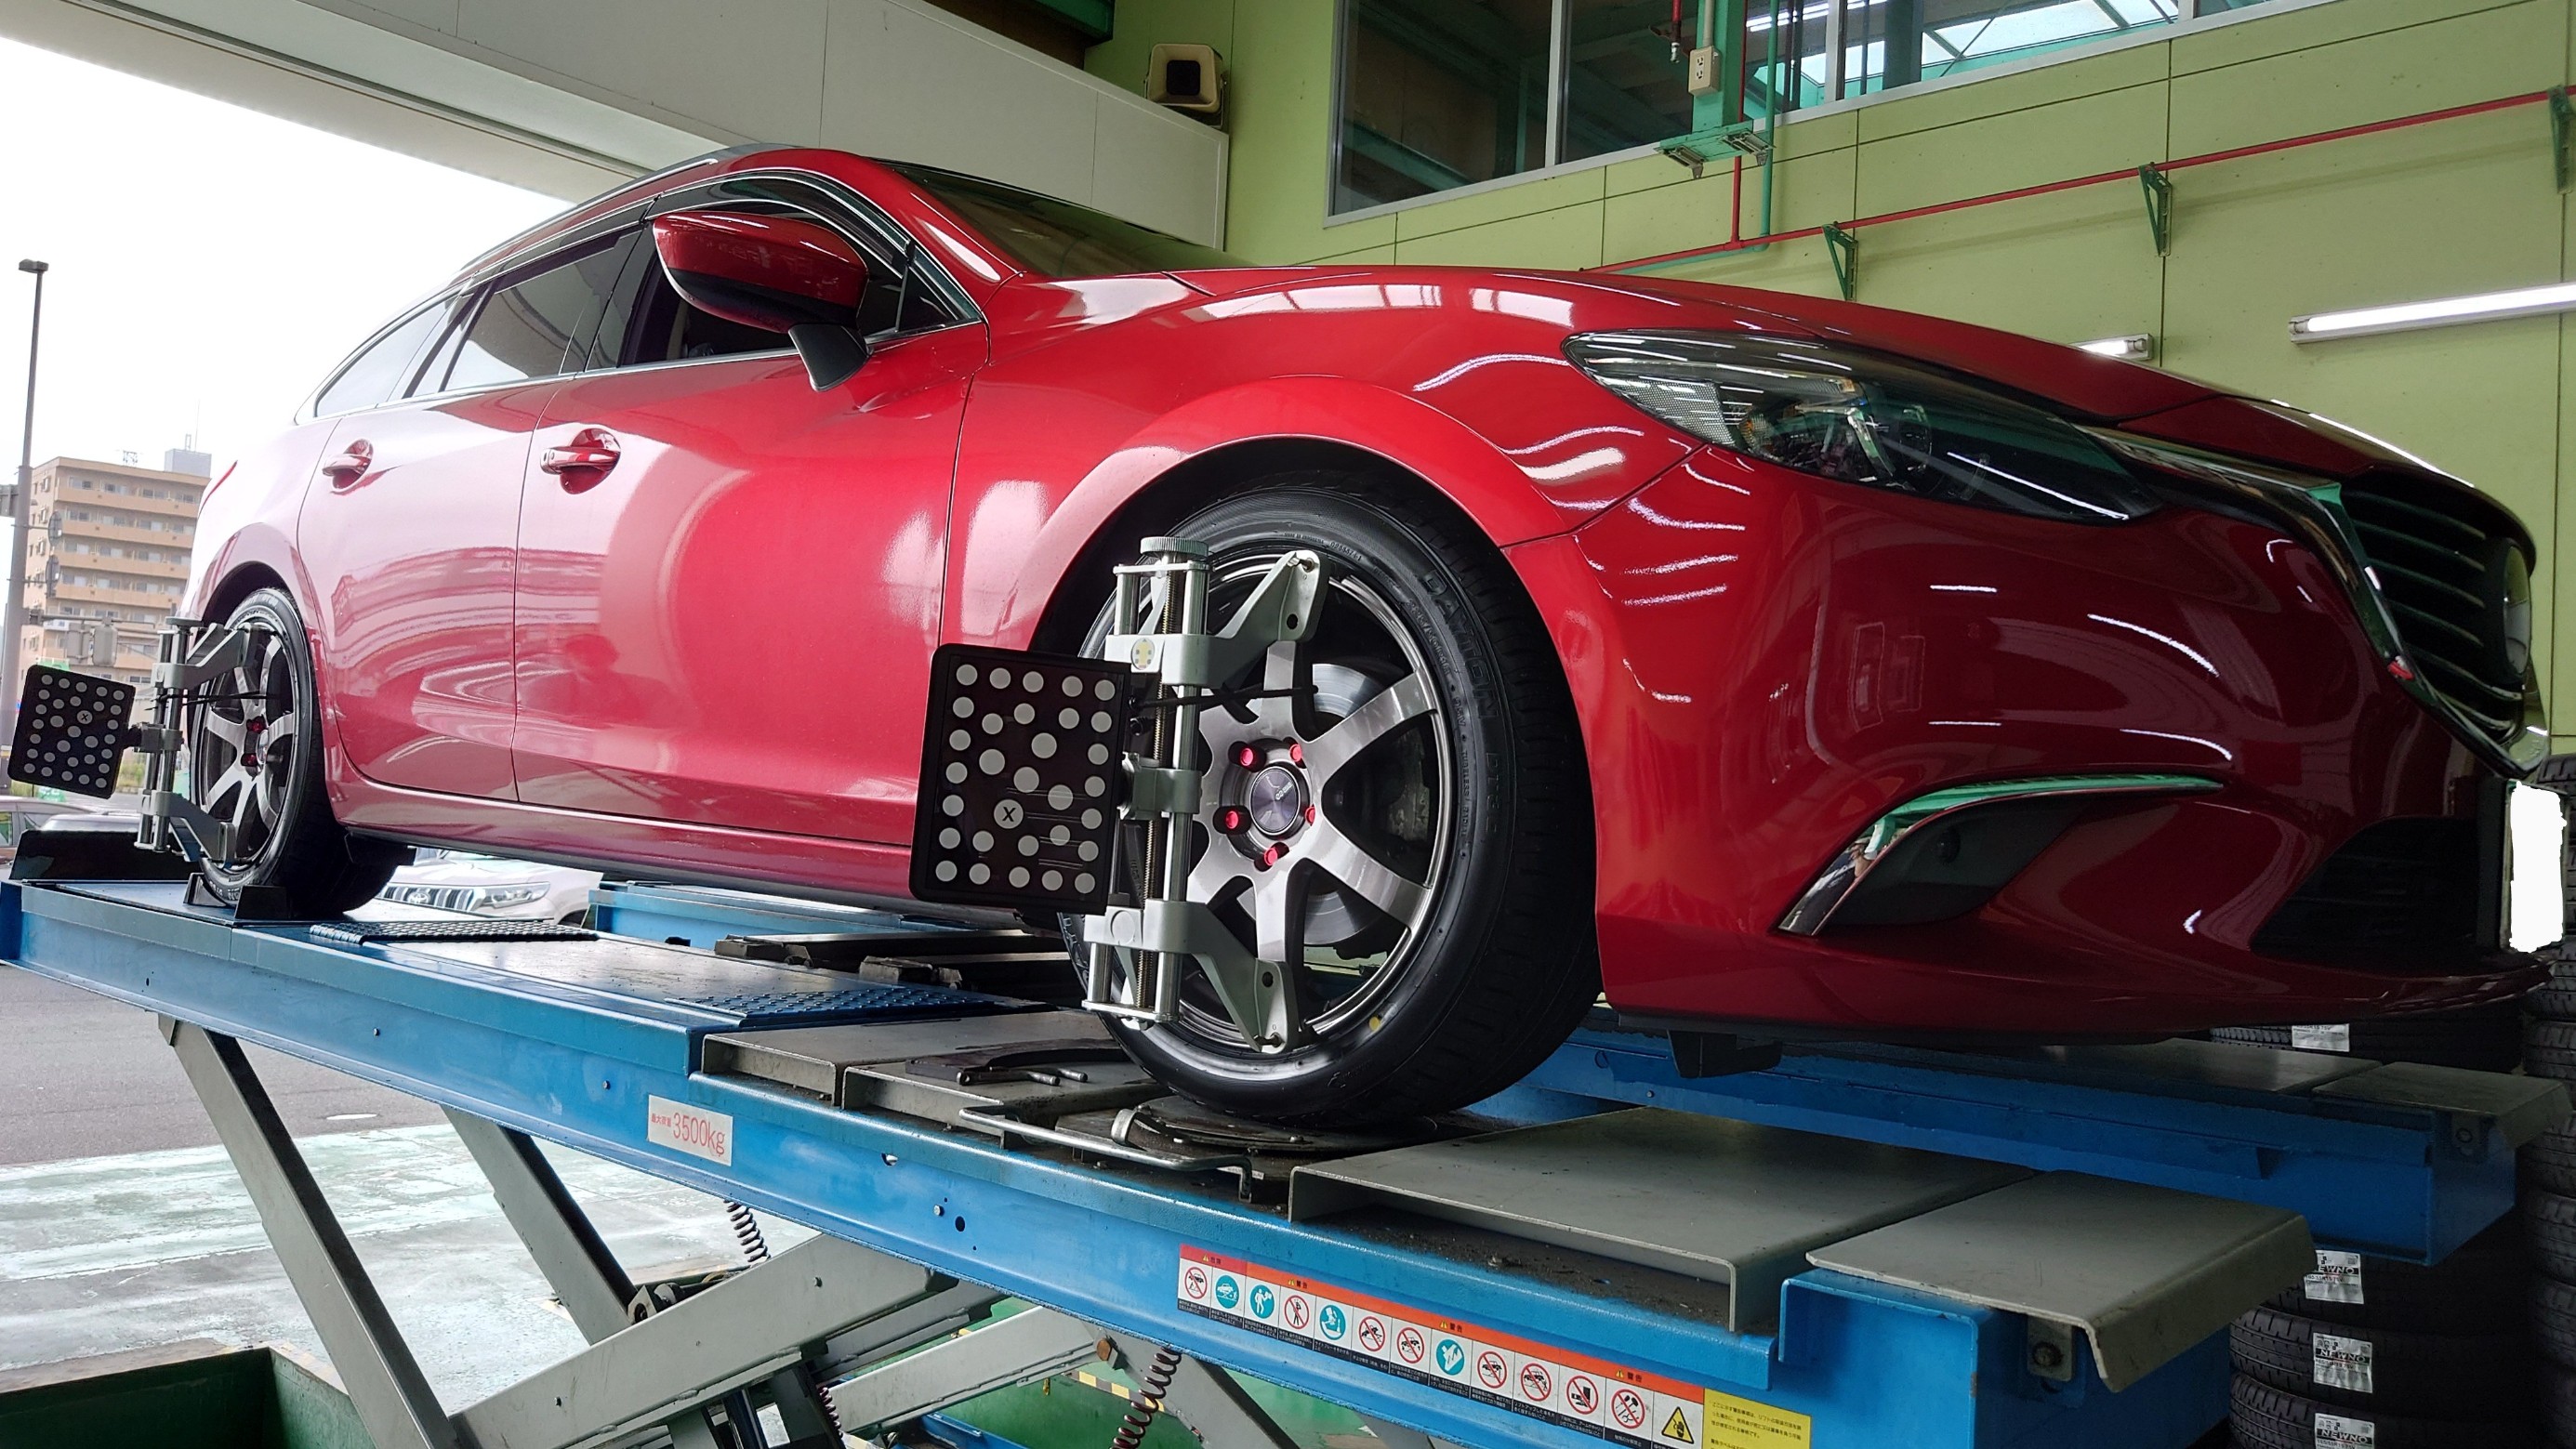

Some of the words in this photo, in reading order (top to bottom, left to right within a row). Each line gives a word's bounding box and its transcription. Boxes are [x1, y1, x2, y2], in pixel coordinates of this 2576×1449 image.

[1418, 569, 1500, 720] DAYTON
[673, 1113, 725, 1155] 3500kg
[2318, 1265, 2355, 1275] EWNO
[1449, 1322, 1463, 1333] 警告
[2319, 1349, 2366, 1363] NEWNO
[1627, 1371, 1643, 1383] 警告
[2321, 1429, 2369, 1444] NEWNO
